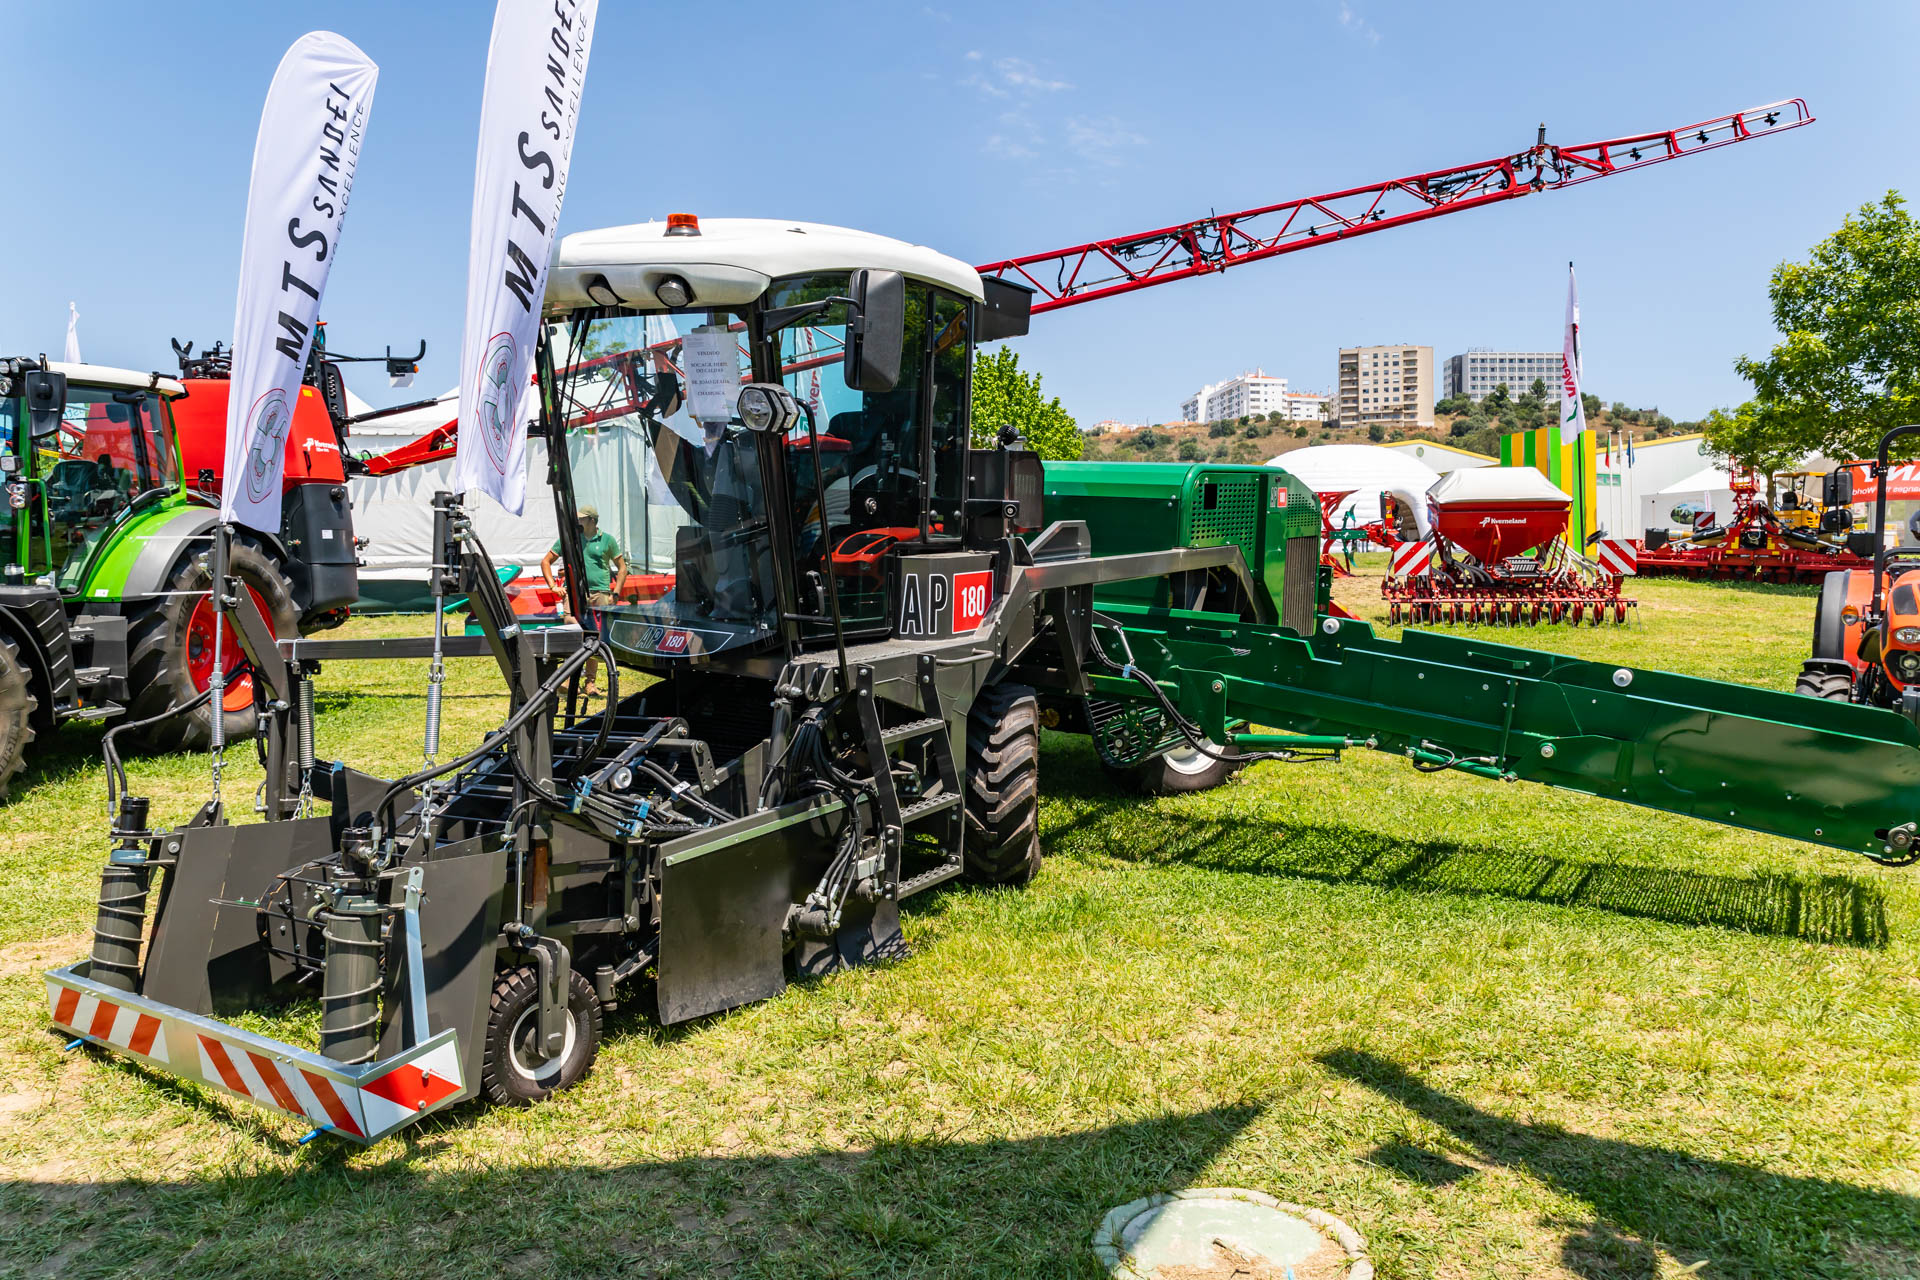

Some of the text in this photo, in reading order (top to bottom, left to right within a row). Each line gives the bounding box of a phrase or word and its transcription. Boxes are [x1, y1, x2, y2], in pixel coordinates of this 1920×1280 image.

[337, 101, 364, 233] EXCELLENCE
[505, 131, 554, 313] MTS
[276, 217, 328, 362] MTS
[636, 627, 685, 649] AP 180
[900, 573, 986, 635] AP 180
